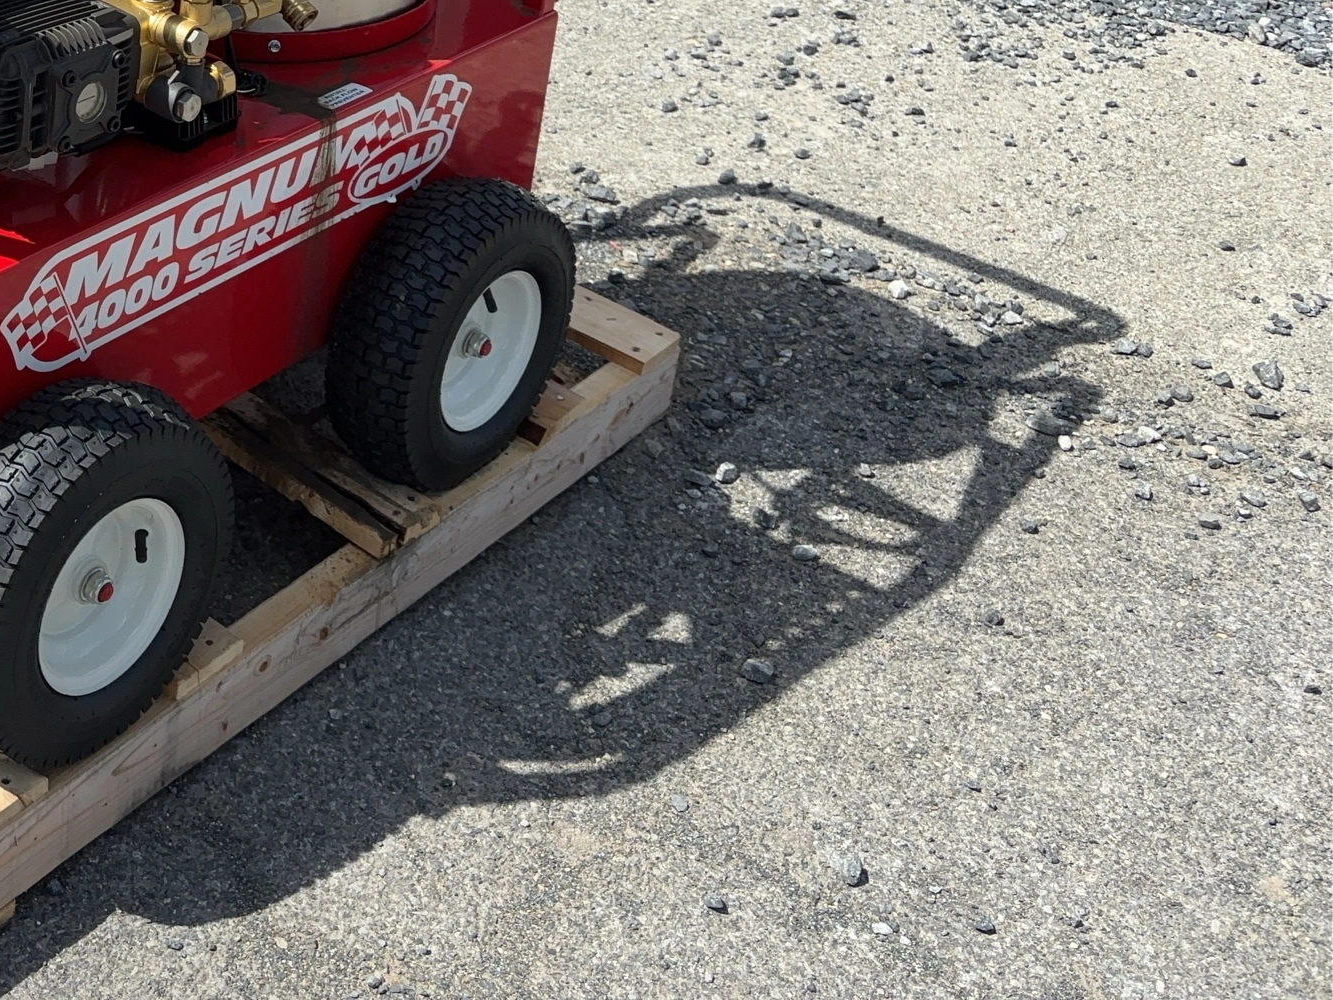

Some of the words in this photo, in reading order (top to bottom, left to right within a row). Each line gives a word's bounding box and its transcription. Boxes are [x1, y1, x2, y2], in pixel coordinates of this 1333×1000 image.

[324, 89, 346, 99] INSTALL
[324, 95, 341, 104] BACK
[341, 88, 358, 97] FLOW
[330, 90, 365, 106] PREVENTER
[357, 132, 442, 198] GOLD
[67, 118, 380, 304] MAGNUM
[69, 260, 179, 341] 4000
[183, 180, 344, 285] SERIES
